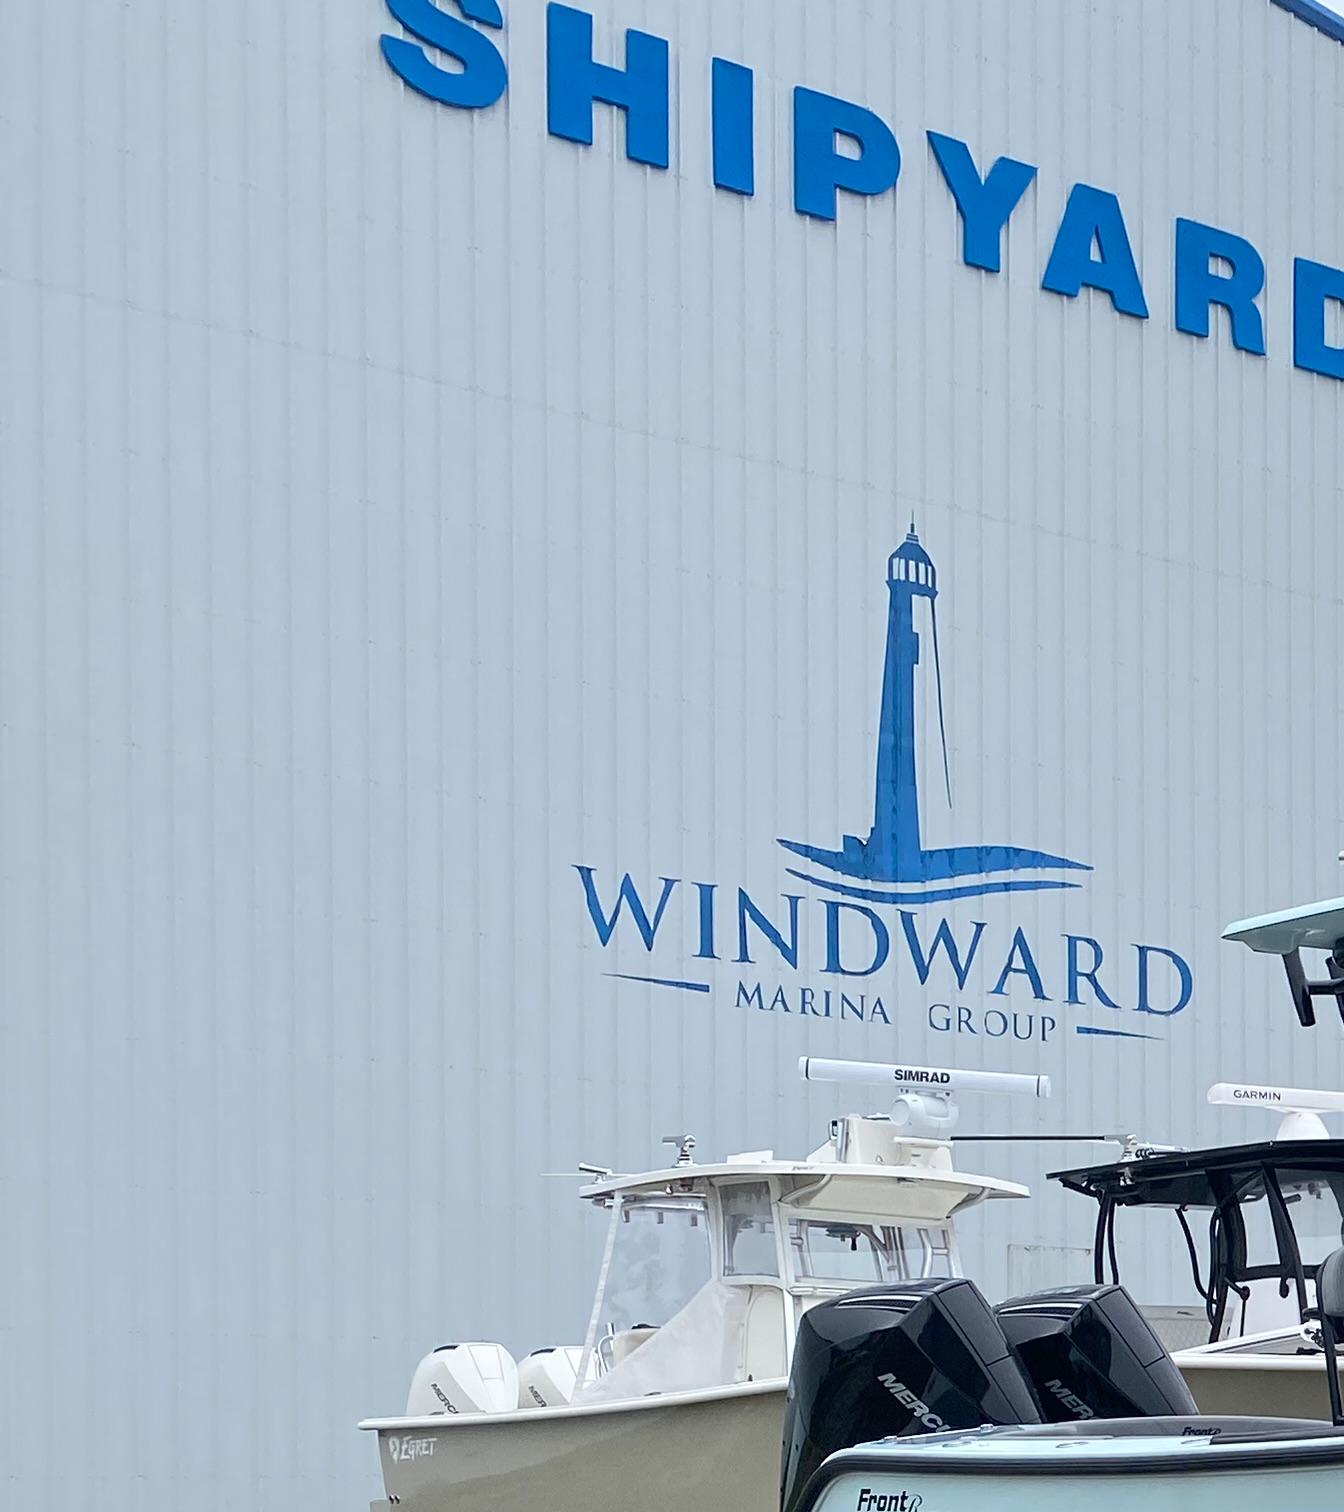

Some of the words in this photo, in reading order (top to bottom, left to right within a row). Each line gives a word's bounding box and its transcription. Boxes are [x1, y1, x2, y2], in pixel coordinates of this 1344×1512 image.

[571, 864, 1194, 1017] WINDWARD
[735, 980, 892, 1025] MARINA
[928, 1003, 1057, 1042] GROUP
[894, 1069, 951, 1084] SIMRAD
[1233, 1089, 1282, 1102] GARMIN
[877, 1372, 951, 1433] MERC
